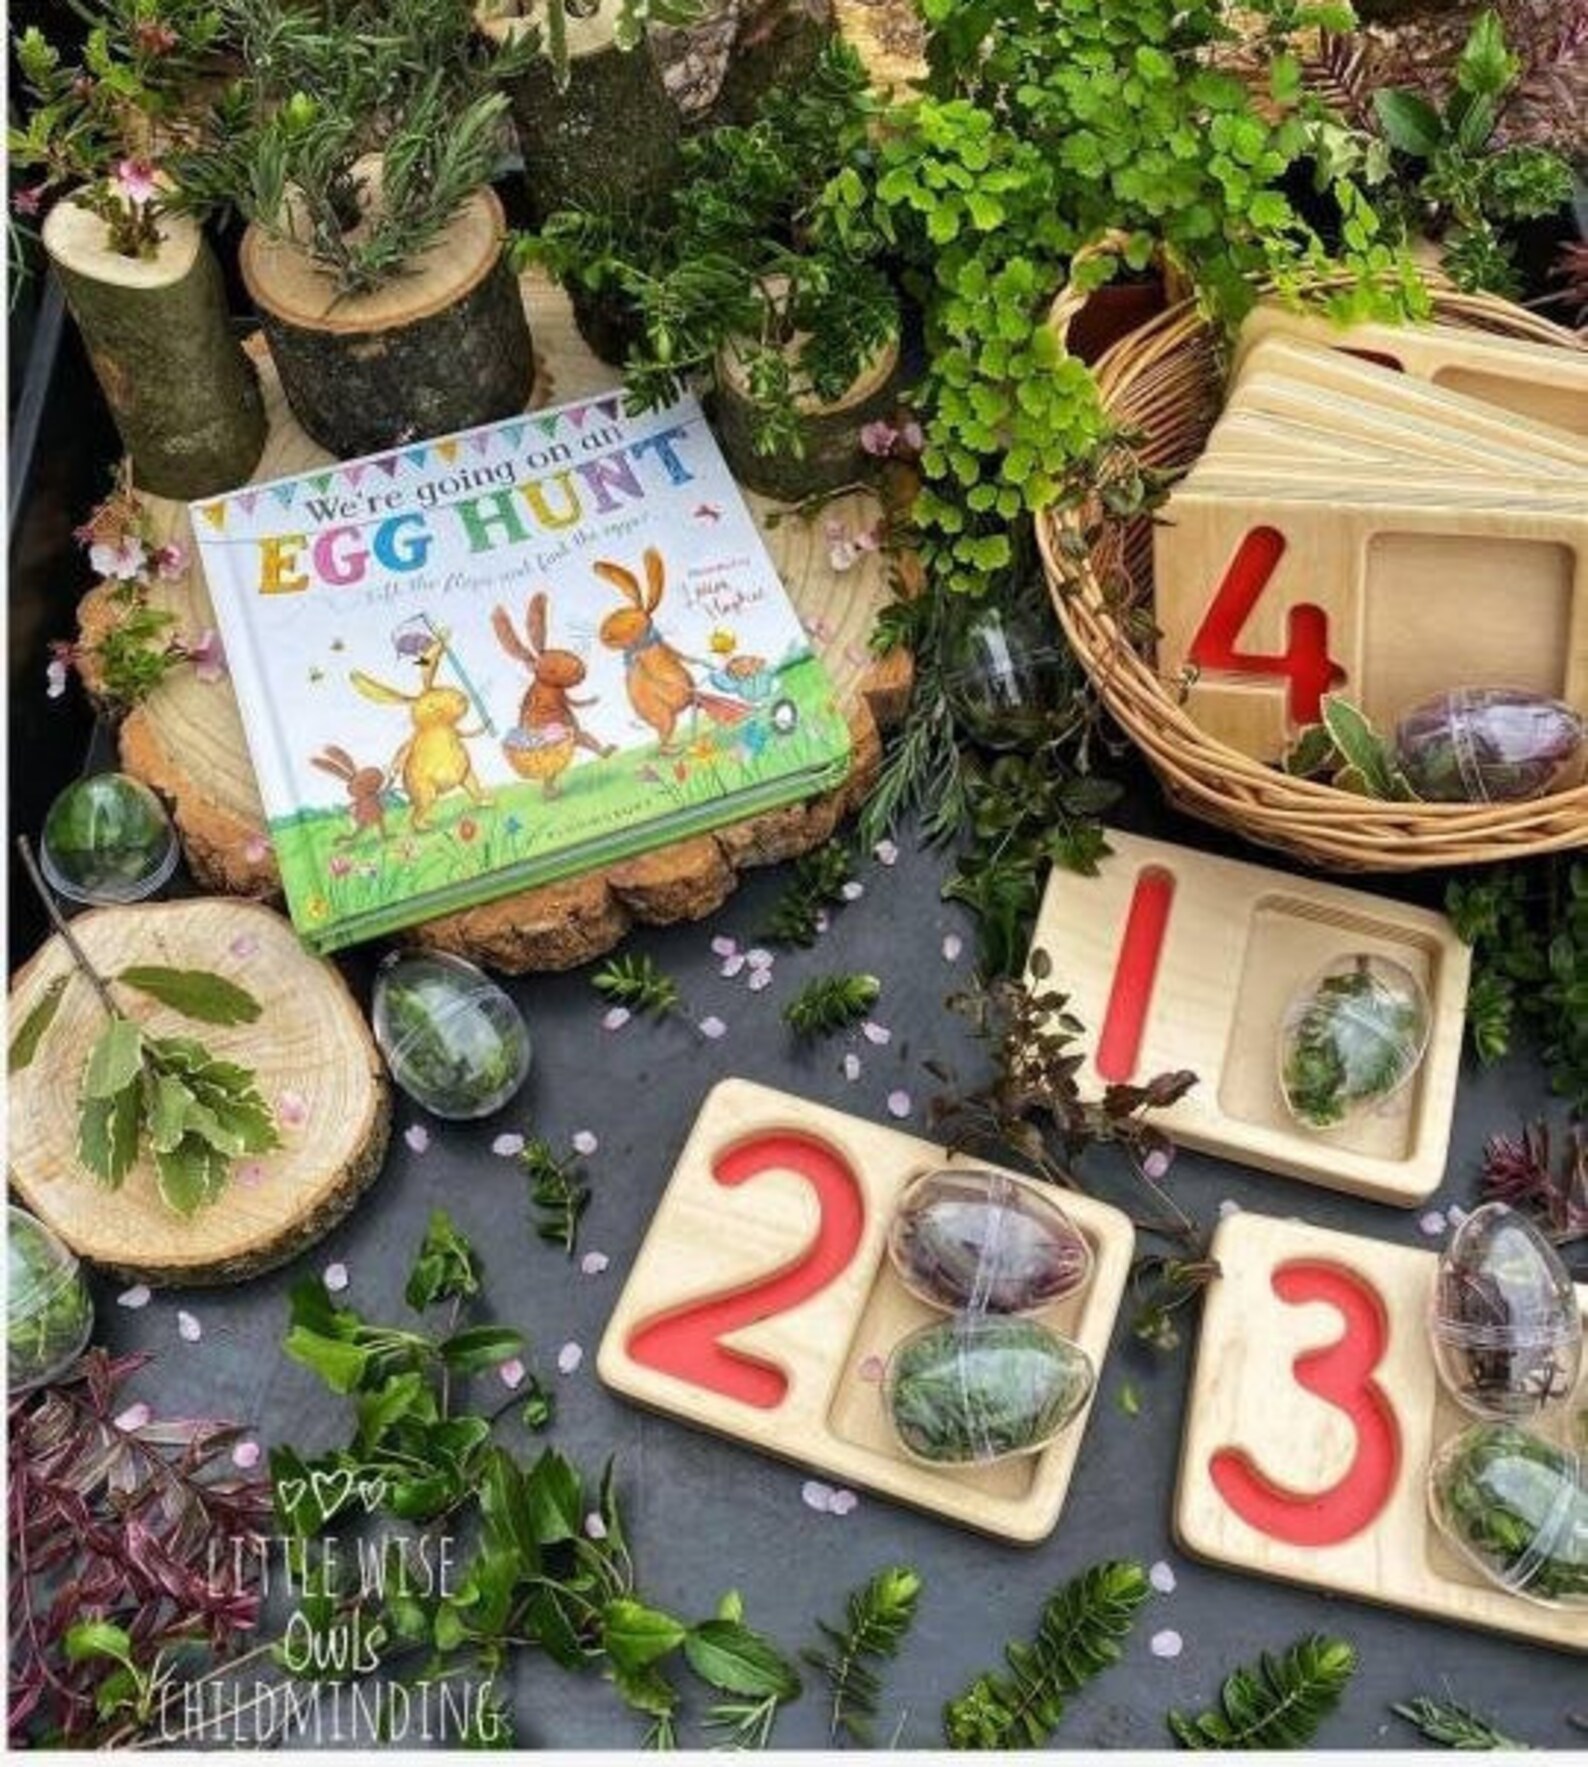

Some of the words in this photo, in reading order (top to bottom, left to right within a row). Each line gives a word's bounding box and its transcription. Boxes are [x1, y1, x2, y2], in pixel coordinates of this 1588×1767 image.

[258, 512, 433, 595] EGG
[453, 425, 695, 553] HUNT
[306, 488, 402, 525] We're
[416, 457, 517, 509] going
[527, 440, 572, 470] on
[581, 423, 625, 451] an
[1187, 524, 1348, 728] 4
[1094, 863, 1177, 1084] 1
[626, 1126, 866, 1409] 2
[1208, 1256, 1402, 1548] 3
